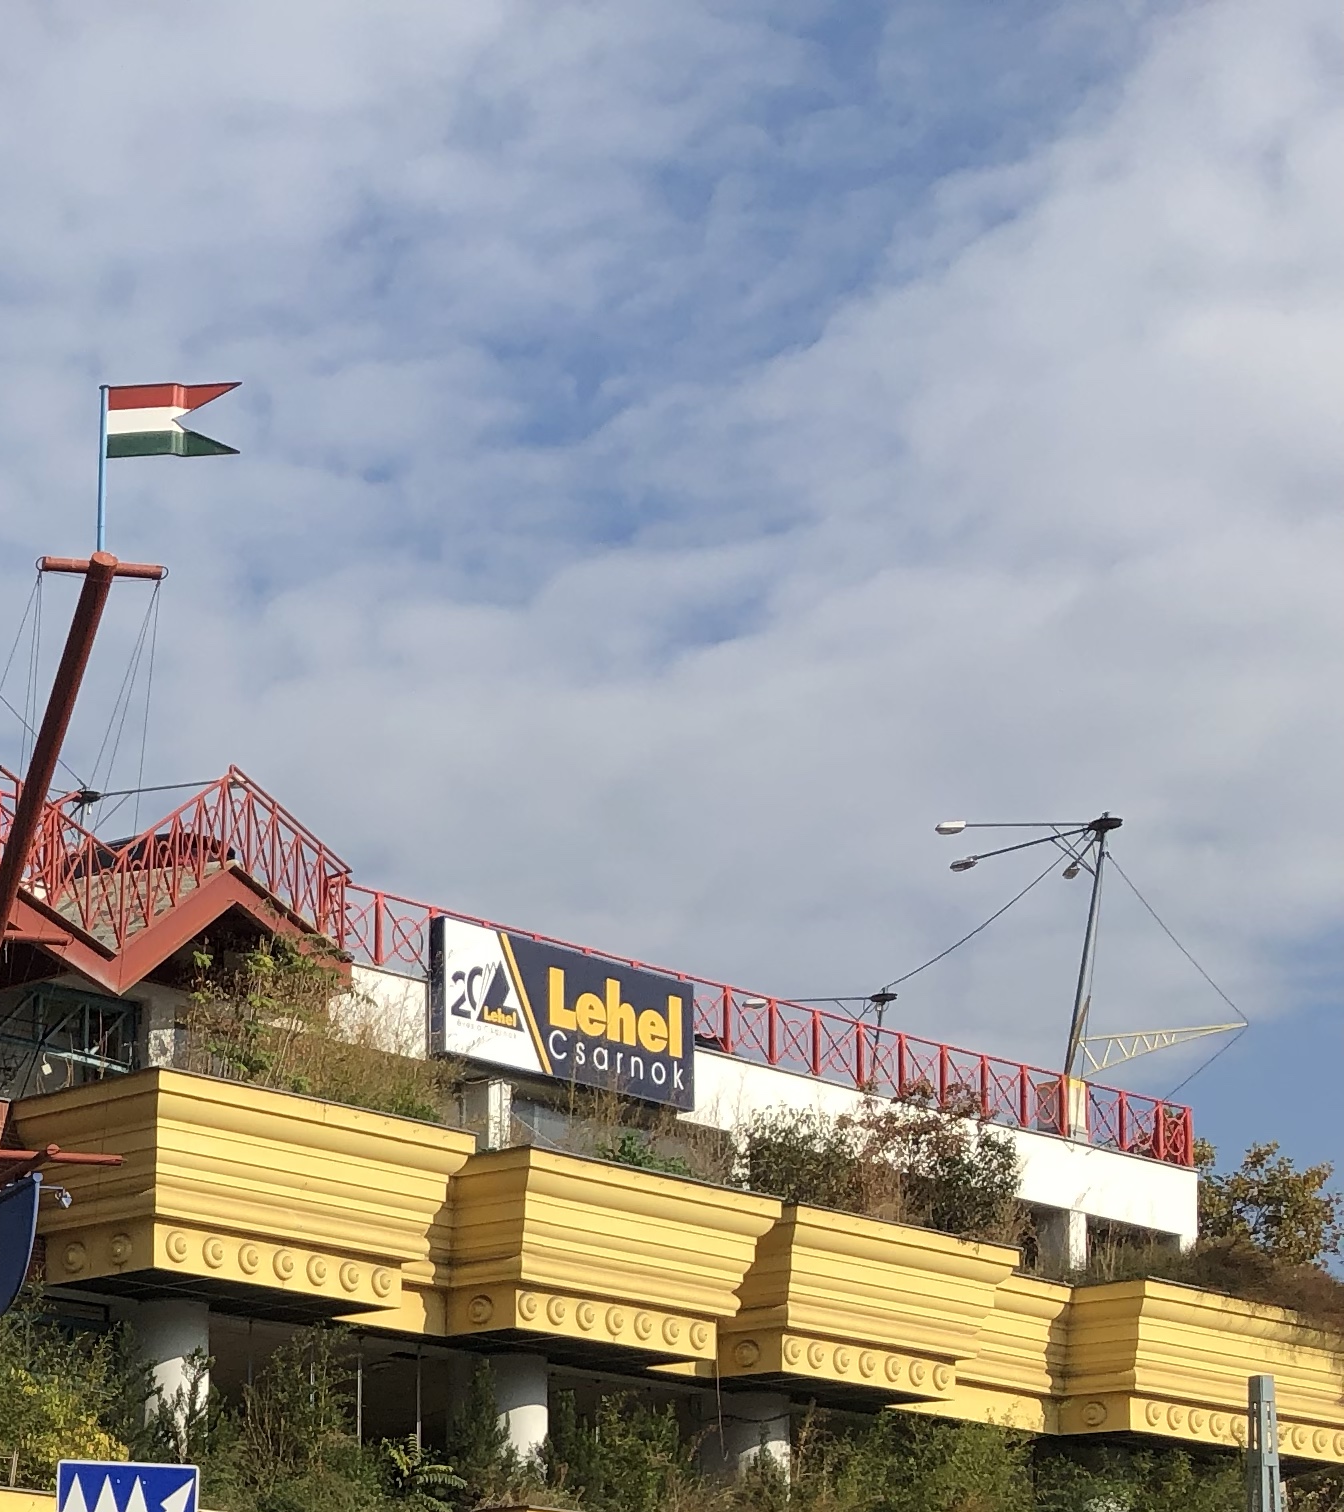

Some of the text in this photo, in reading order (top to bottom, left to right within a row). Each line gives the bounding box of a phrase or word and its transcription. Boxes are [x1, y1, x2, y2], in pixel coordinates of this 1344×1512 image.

[483, 1004, 517, 1027] Lehel
[547, 966, 683, 1059] Lehel
[548, 1029, 685, 1091] Csarnok
